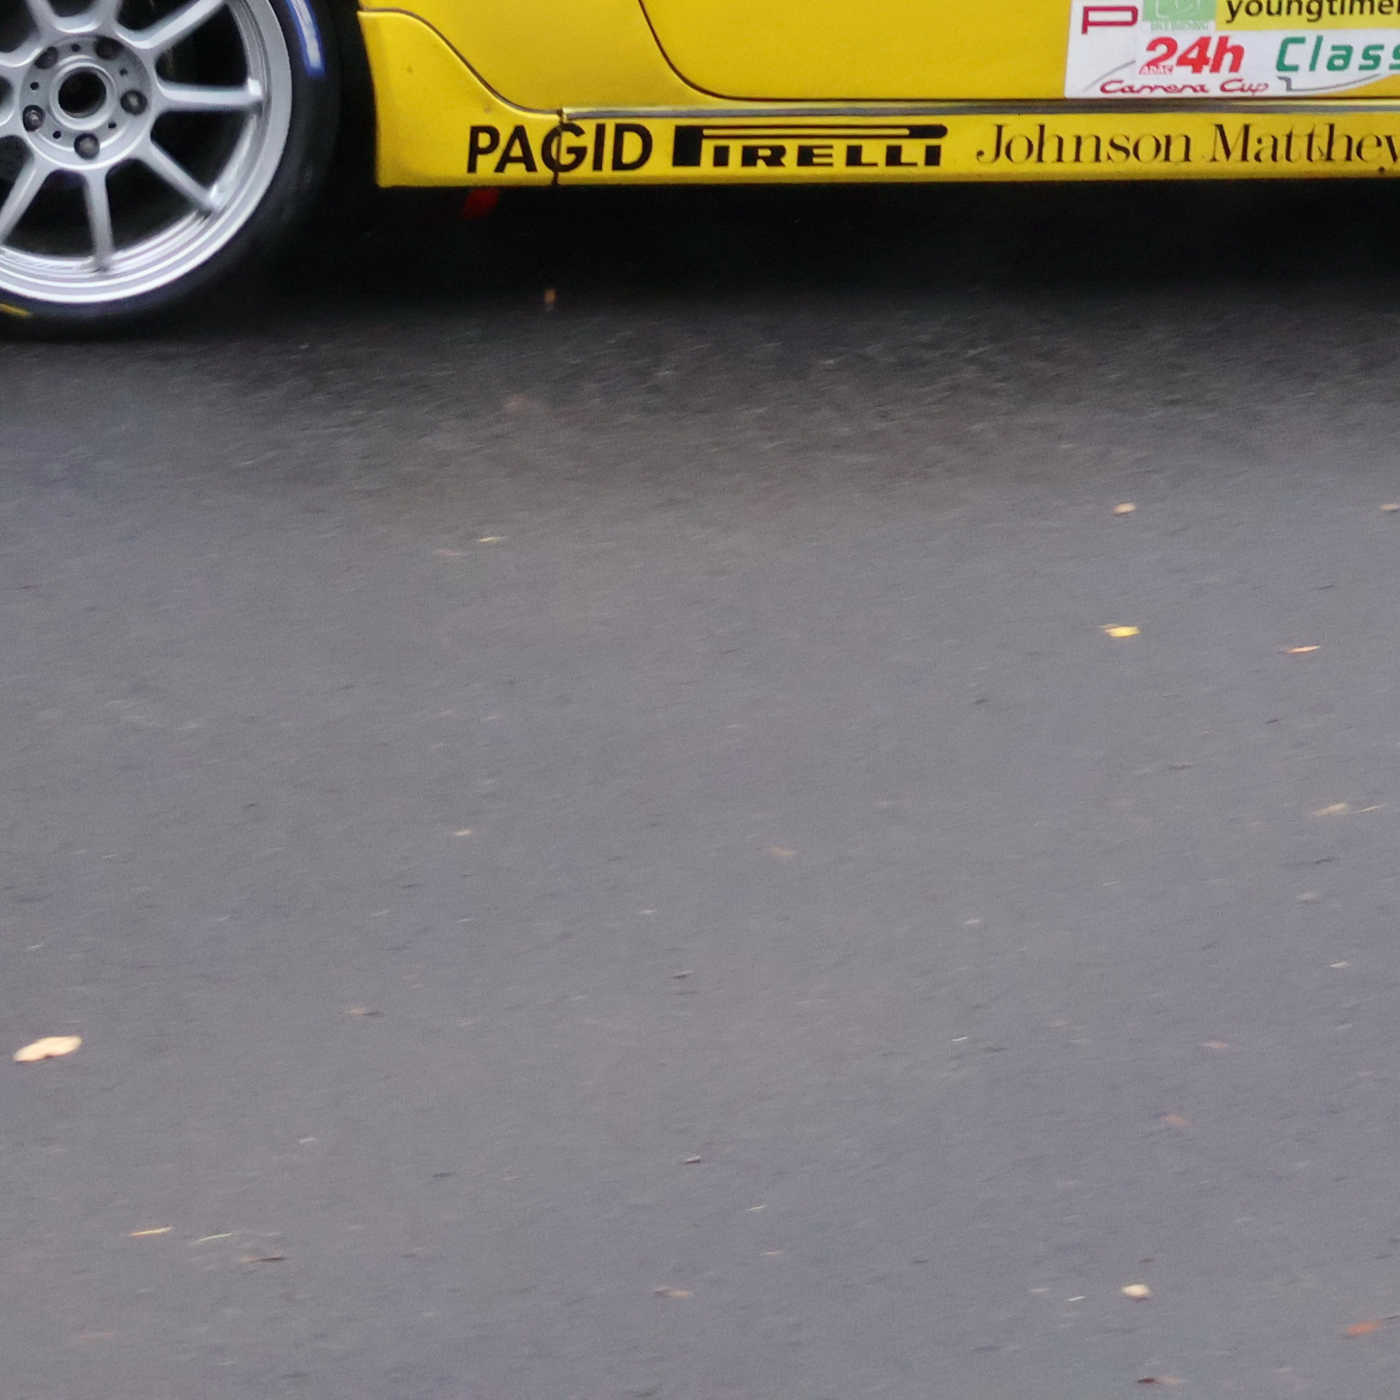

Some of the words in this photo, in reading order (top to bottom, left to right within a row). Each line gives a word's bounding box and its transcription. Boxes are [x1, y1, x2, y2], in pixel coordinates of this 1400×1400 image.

[1138, 35, 1246, 75] 24h
[1219, 78, 1269, 96] Cup
[466, 122, 653, 174] PAGID
[671, 123, 949, 168] PIRELLI
[975, 123, 1193, 164] Johnson
